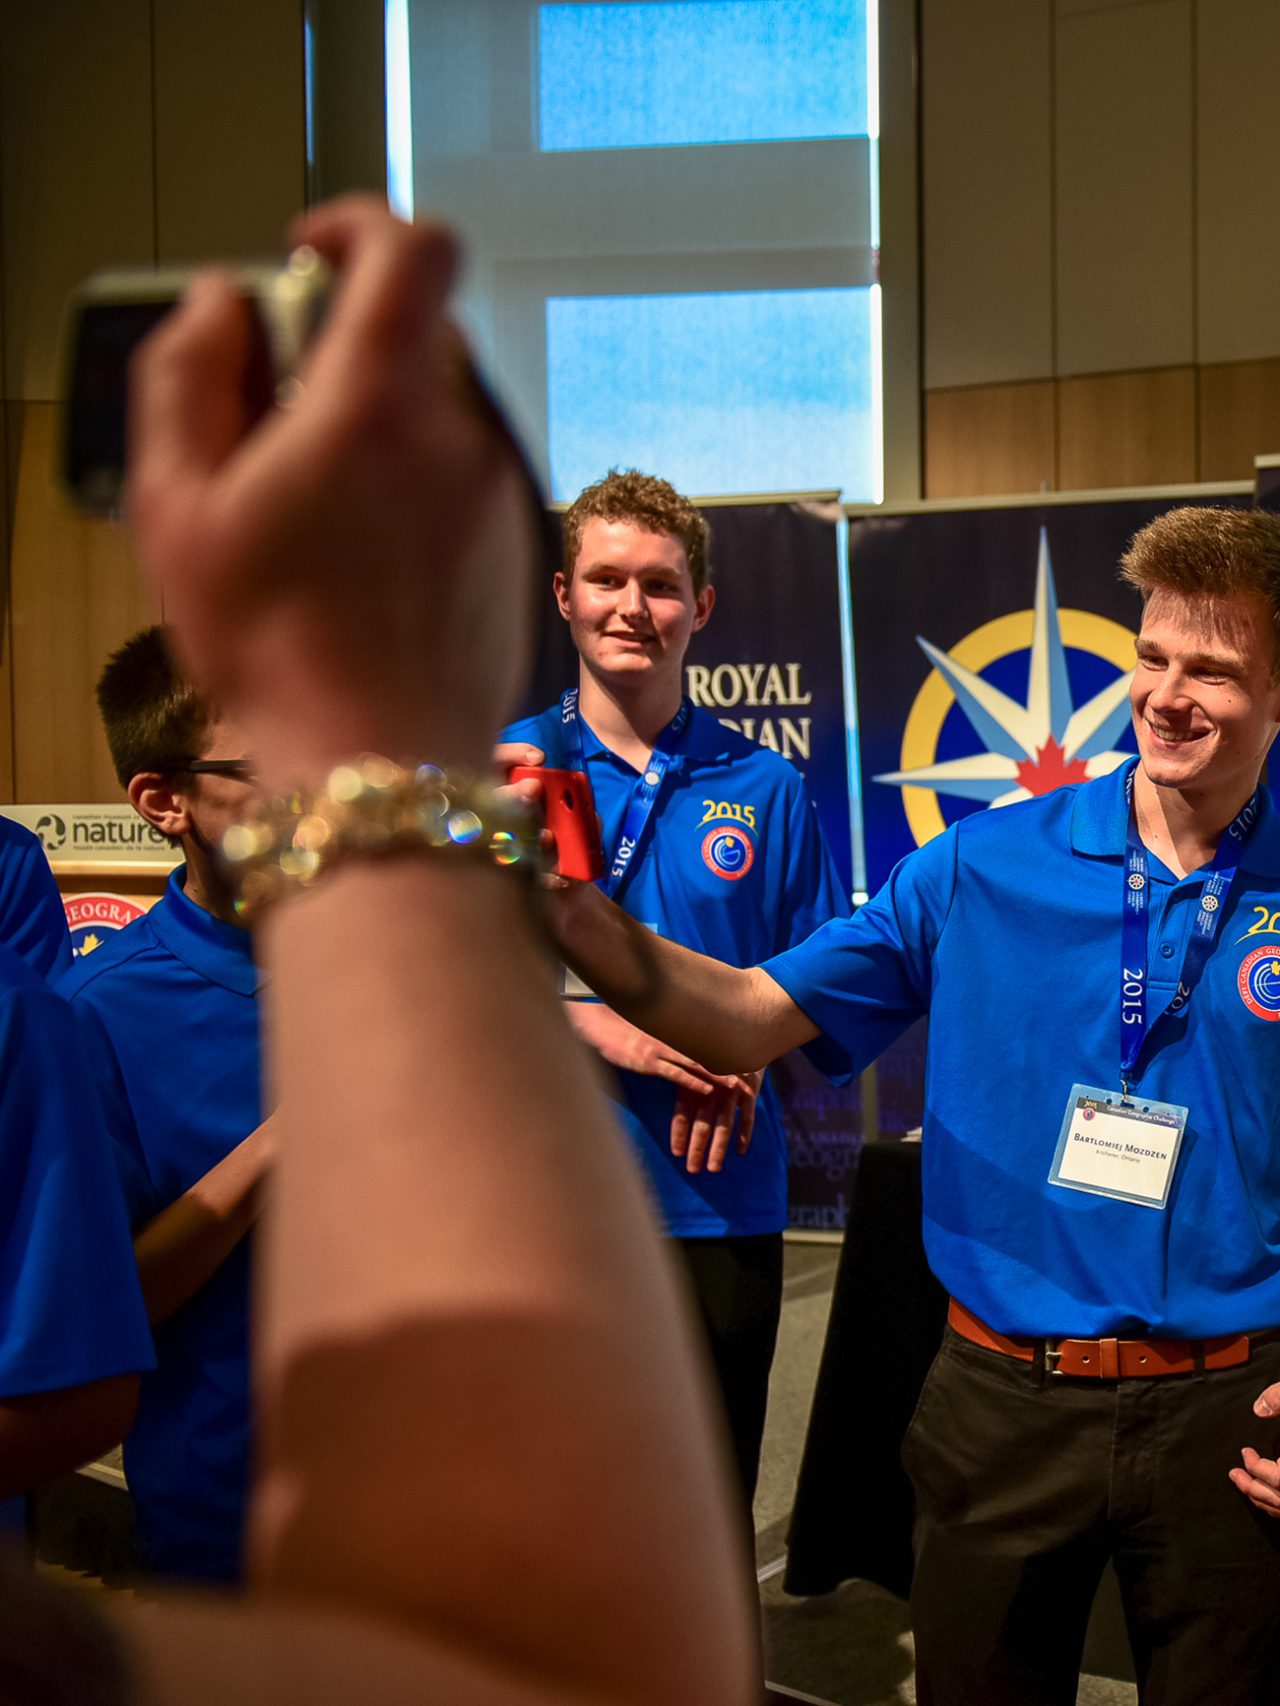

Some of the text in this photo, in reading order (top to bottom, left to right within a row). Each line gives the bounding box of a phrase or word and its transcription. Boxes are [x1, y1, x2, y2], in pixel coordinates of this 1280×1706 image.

[685, 662, 813, 708] ROYAL
[73, 821, 165, 843] nature
[702, 799, 756, 828] 2015
[611, 836, 636, 878] 2015
[1121, 968, 1143, 1026] 2015
